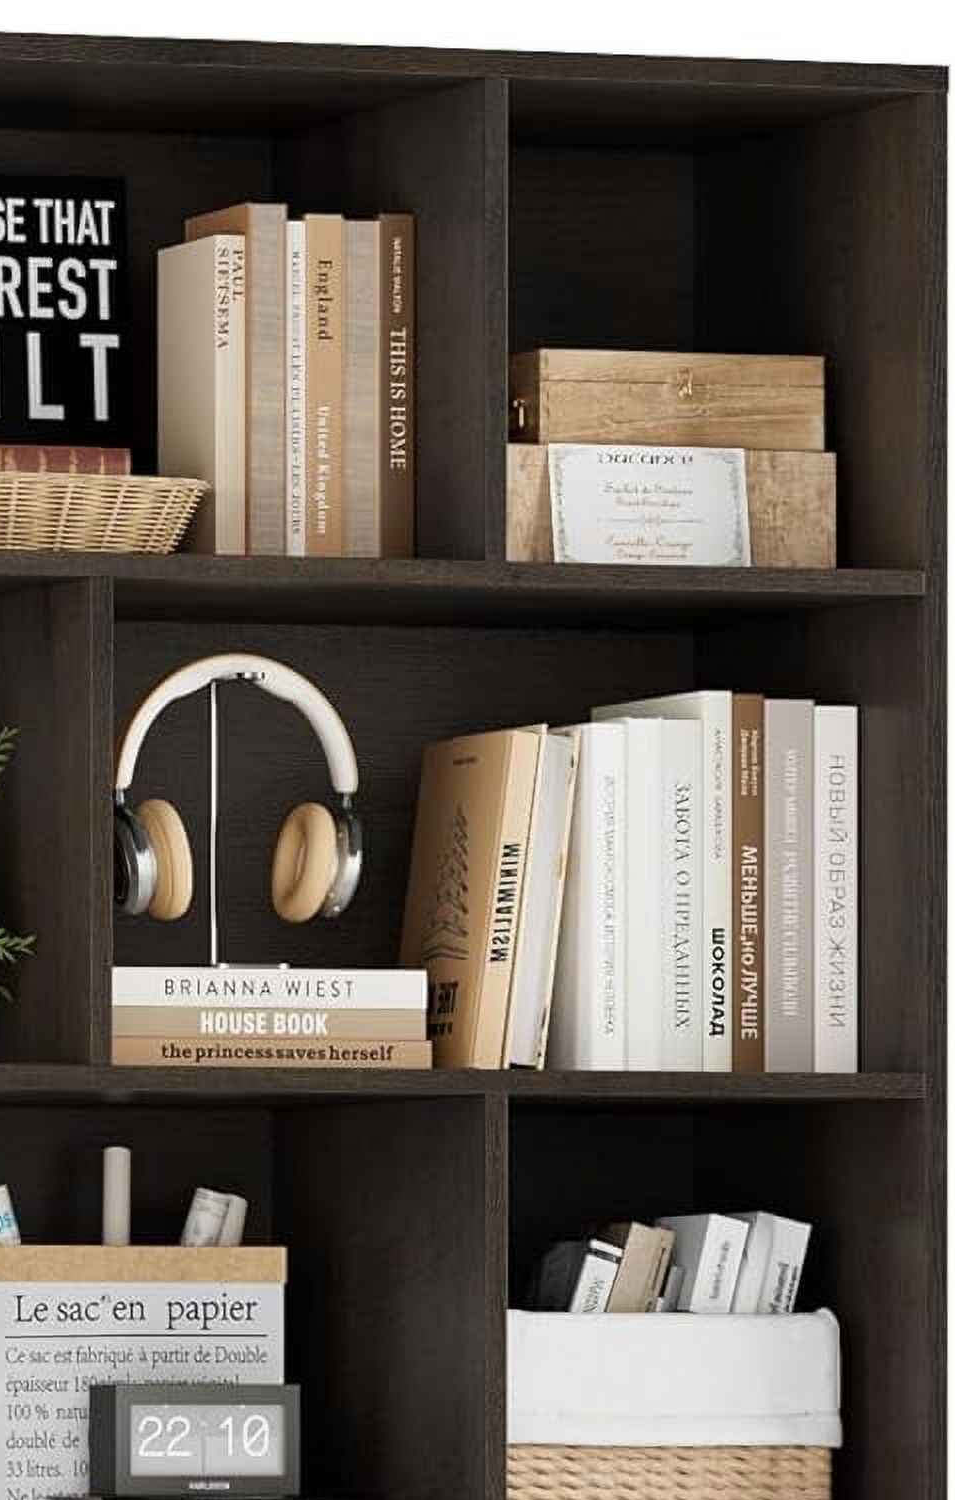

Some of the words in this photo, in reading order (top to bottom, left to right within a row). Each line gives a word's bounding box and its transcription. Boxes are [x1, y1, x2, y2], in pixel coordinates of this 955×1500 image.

[33, 198, 115, 245] THAT
[216, 247, 230, 350] SIETSEMA
[232, 249, 244, 302] PAUL
[315, 259, 334, 342] England
[389, 327, 407, 376] THIS
[389, 382, 407, 400] IS
[316, 405, 331, 458] United
[389, 406, 407, 470] HOME
[314, 464, 331, 535] Kingdom
[674, 783, 691, 861] ЗАБОТА
[827, 754, 849, 843] НОВЫЙ
[827, 853, 849, 930] ОБРАЗ
[672, 891, 691, 1029] ПРЕДАННЫХ
[708, 927, 726, 1037] ШОКОЛАД
[827, 938, 849, 1028] ЖИЗНИ
[164, 978, 273, 997] BRIANNA
[283, 979, 357, 998] WIEST
[739, 968, 759, 1040] ЛУЧШЕ
[200, 1010, 267, 1035] HOUSE
[273, 1011, 328, 1036] BOOK
[161, 1044, 192, 1059] the
[194, 1045, 276, 1064] princess
[276, 1048, 326, 1061] saves
[329, 1045, 394, 1062] herself
[14, 1294, 48, 1323] Le
[112, 1298, 145, 1323] en
[165, 1293, 259, 1330] papier
[5, 1346, 26, 1364] Ce
[151, 1348, 190, 1369] partir
[193, 1346, 212, 1364] de
[214, 1347, 268, 1364] Double
[6, 1403, 32, 1421] 100
[62, 1430, 81, 1449] de
